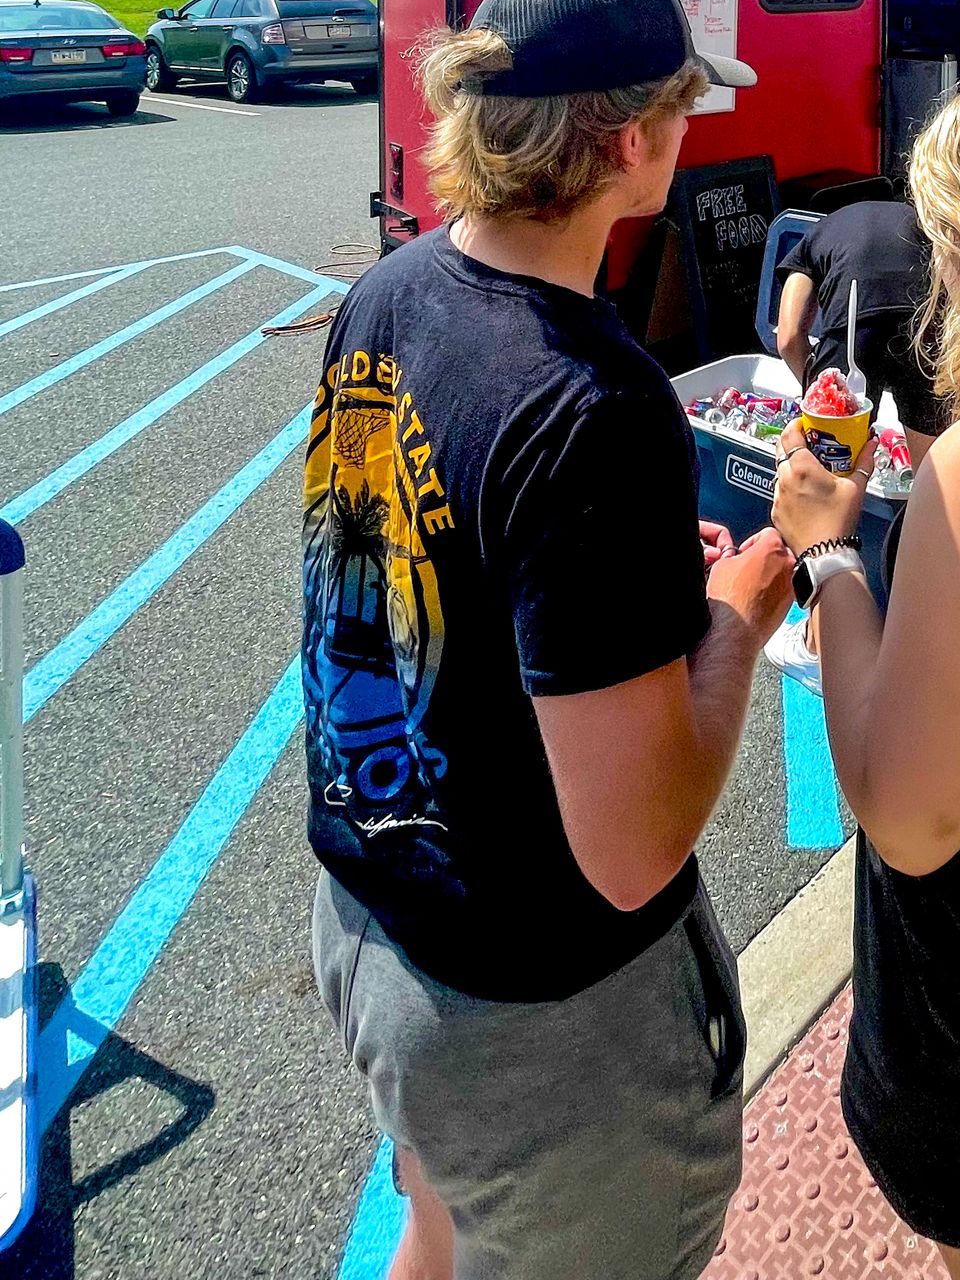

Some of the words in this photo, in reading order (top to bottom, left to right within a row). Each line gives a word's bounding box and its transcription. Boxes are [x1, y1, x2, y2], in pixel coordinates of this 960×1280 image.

[696, 184, 747, 221] FREE
[715, 213, 768, 251] FOOD
[398, 392, 455, 535] STATE
